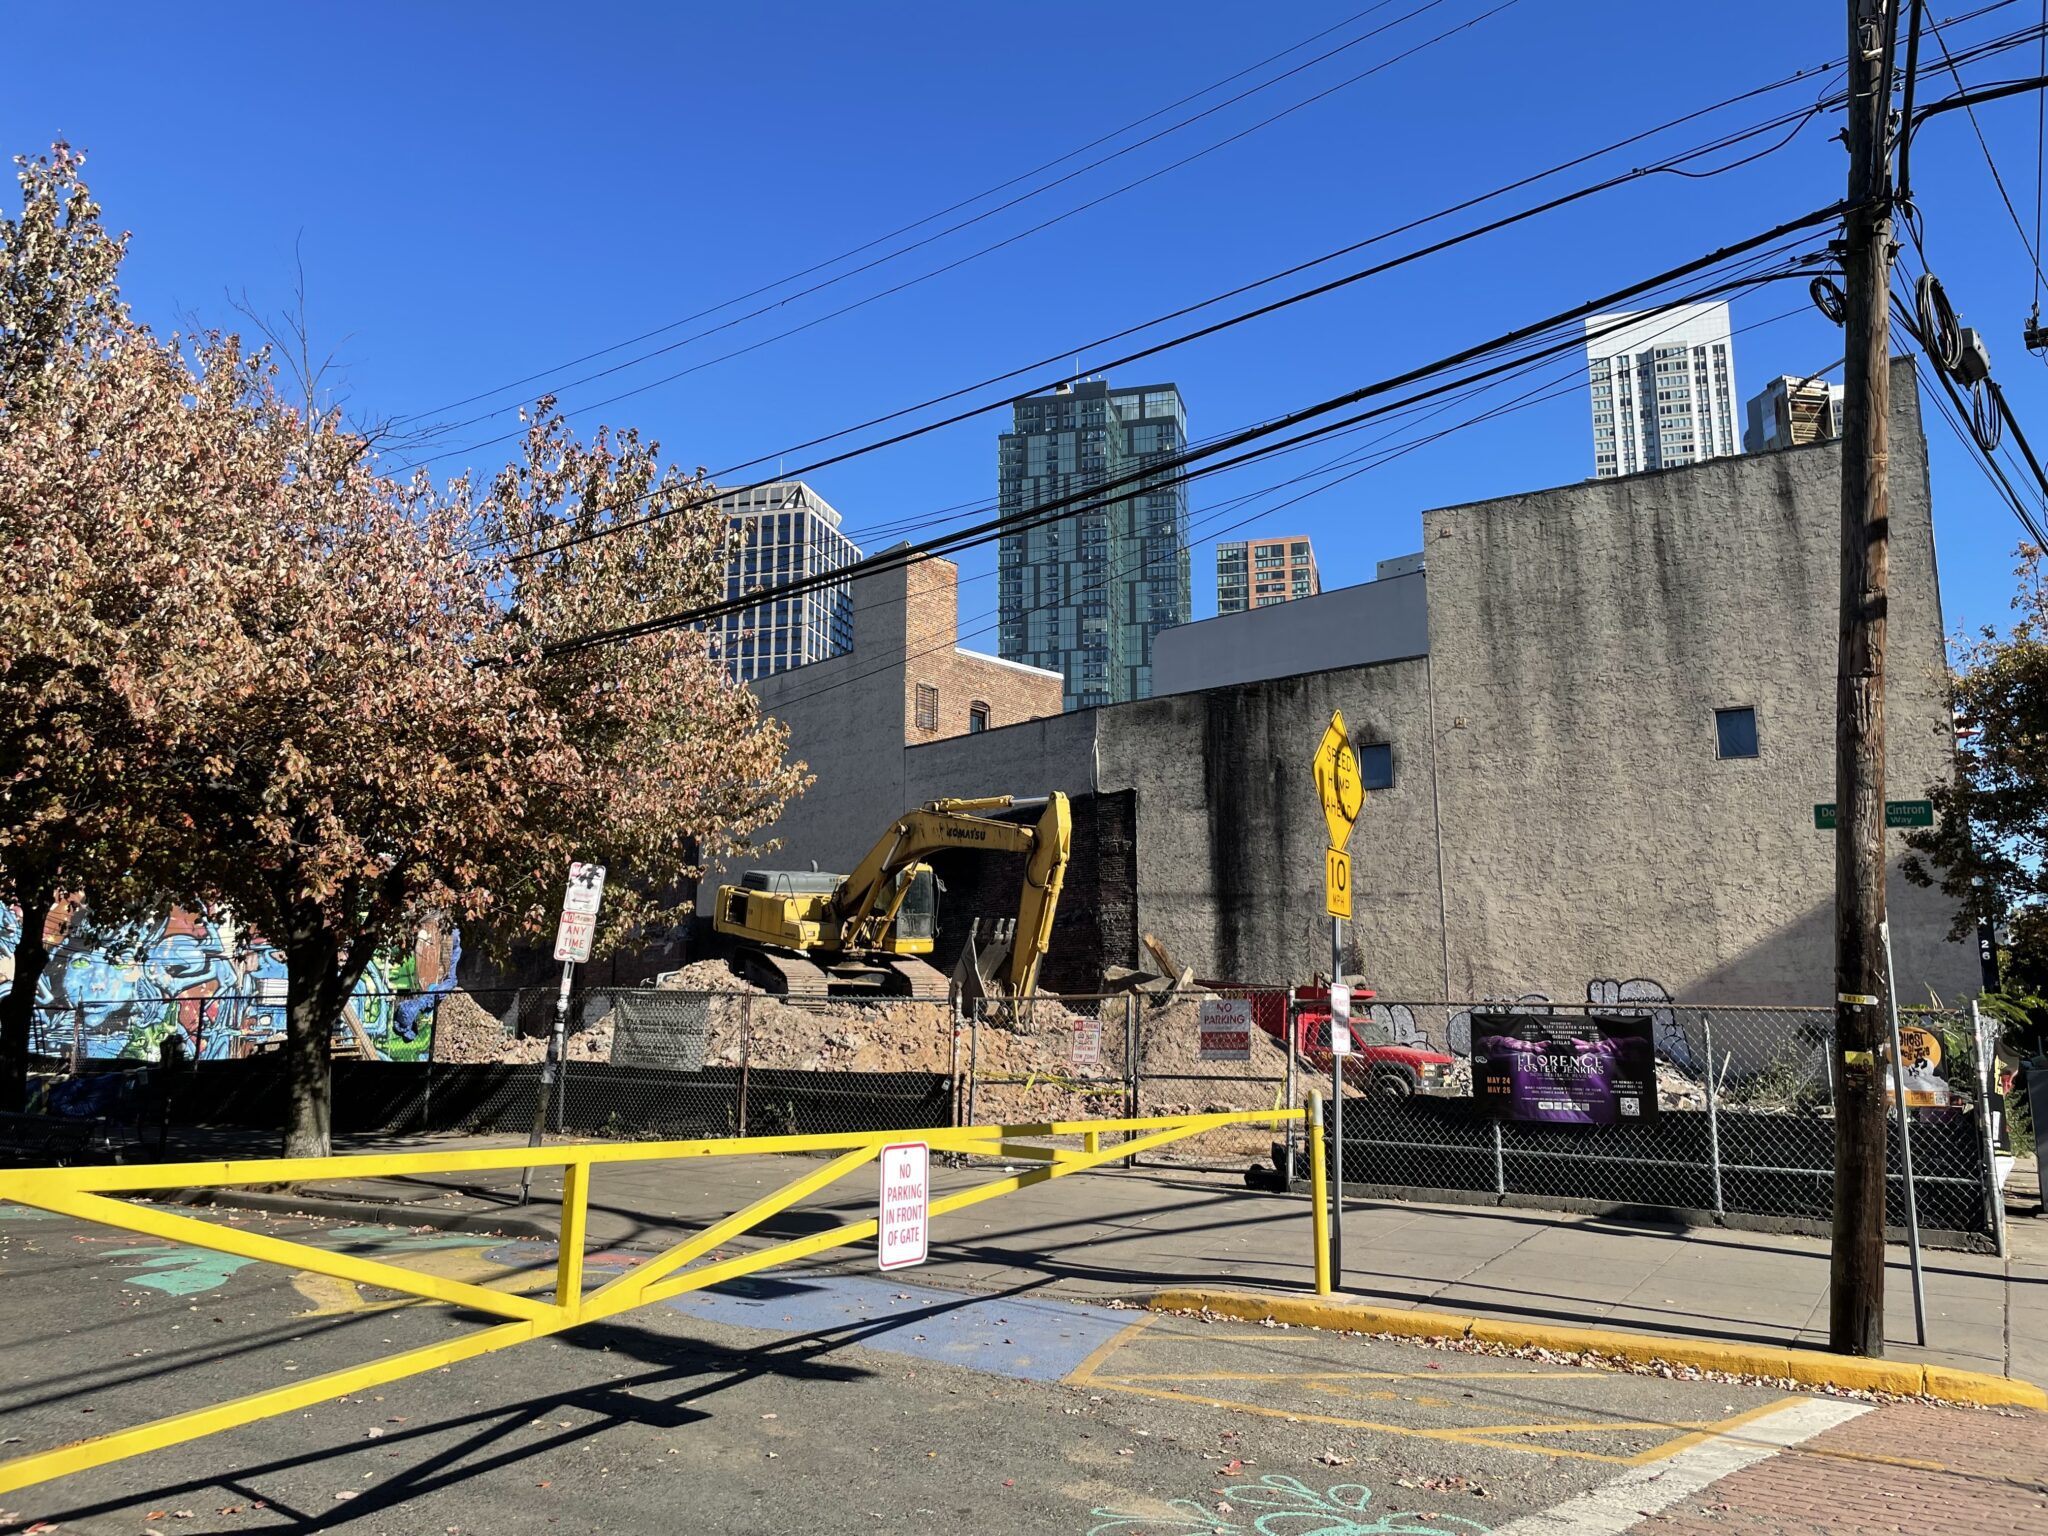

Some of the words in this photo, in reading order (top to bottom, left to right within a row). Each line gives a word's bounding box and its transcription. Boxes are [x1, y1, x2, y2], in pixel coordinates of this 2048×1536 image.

[1327, 745, 1351, 773] SPEED
[1327, 770, 1350, 795] HUMP
[1325, 800, 1352, 819] AHEAD
[1886, 805, 1925, 815] Cintron
[1890, 816, 1912, 824] Way
[946, 828, 986, 841] KOMATSU
[1330, 856, 1347, 892] 10
[1332, 893, 1345, 908] MPH
[562, 912, 575, 923] NO
[566, 925, 587, 936] ANY
[563, 938, 585, 949] TIME
[1216, 1002, 1232, 1013] NO
[1204, 1014, 1245, 1025] PARKING
[1517, 1055, 1604, 1068] FLORENCE
[1517, 1065, 1557, 1073] FOSTER
[1563, 1066, 1604, 1075] JENKINS
[1487, 1076, 1500, 1084] MAY
[899, 1163, 911, 1179] NO
[887, 1183, 922, 1203] PARKING
[885, 1209, 895, 1225] IN
[896, 1204, 923, 1223] FRONT
[887, 1230, 899, 1247] OF
[900, 1226, 920, 1244] GATE
